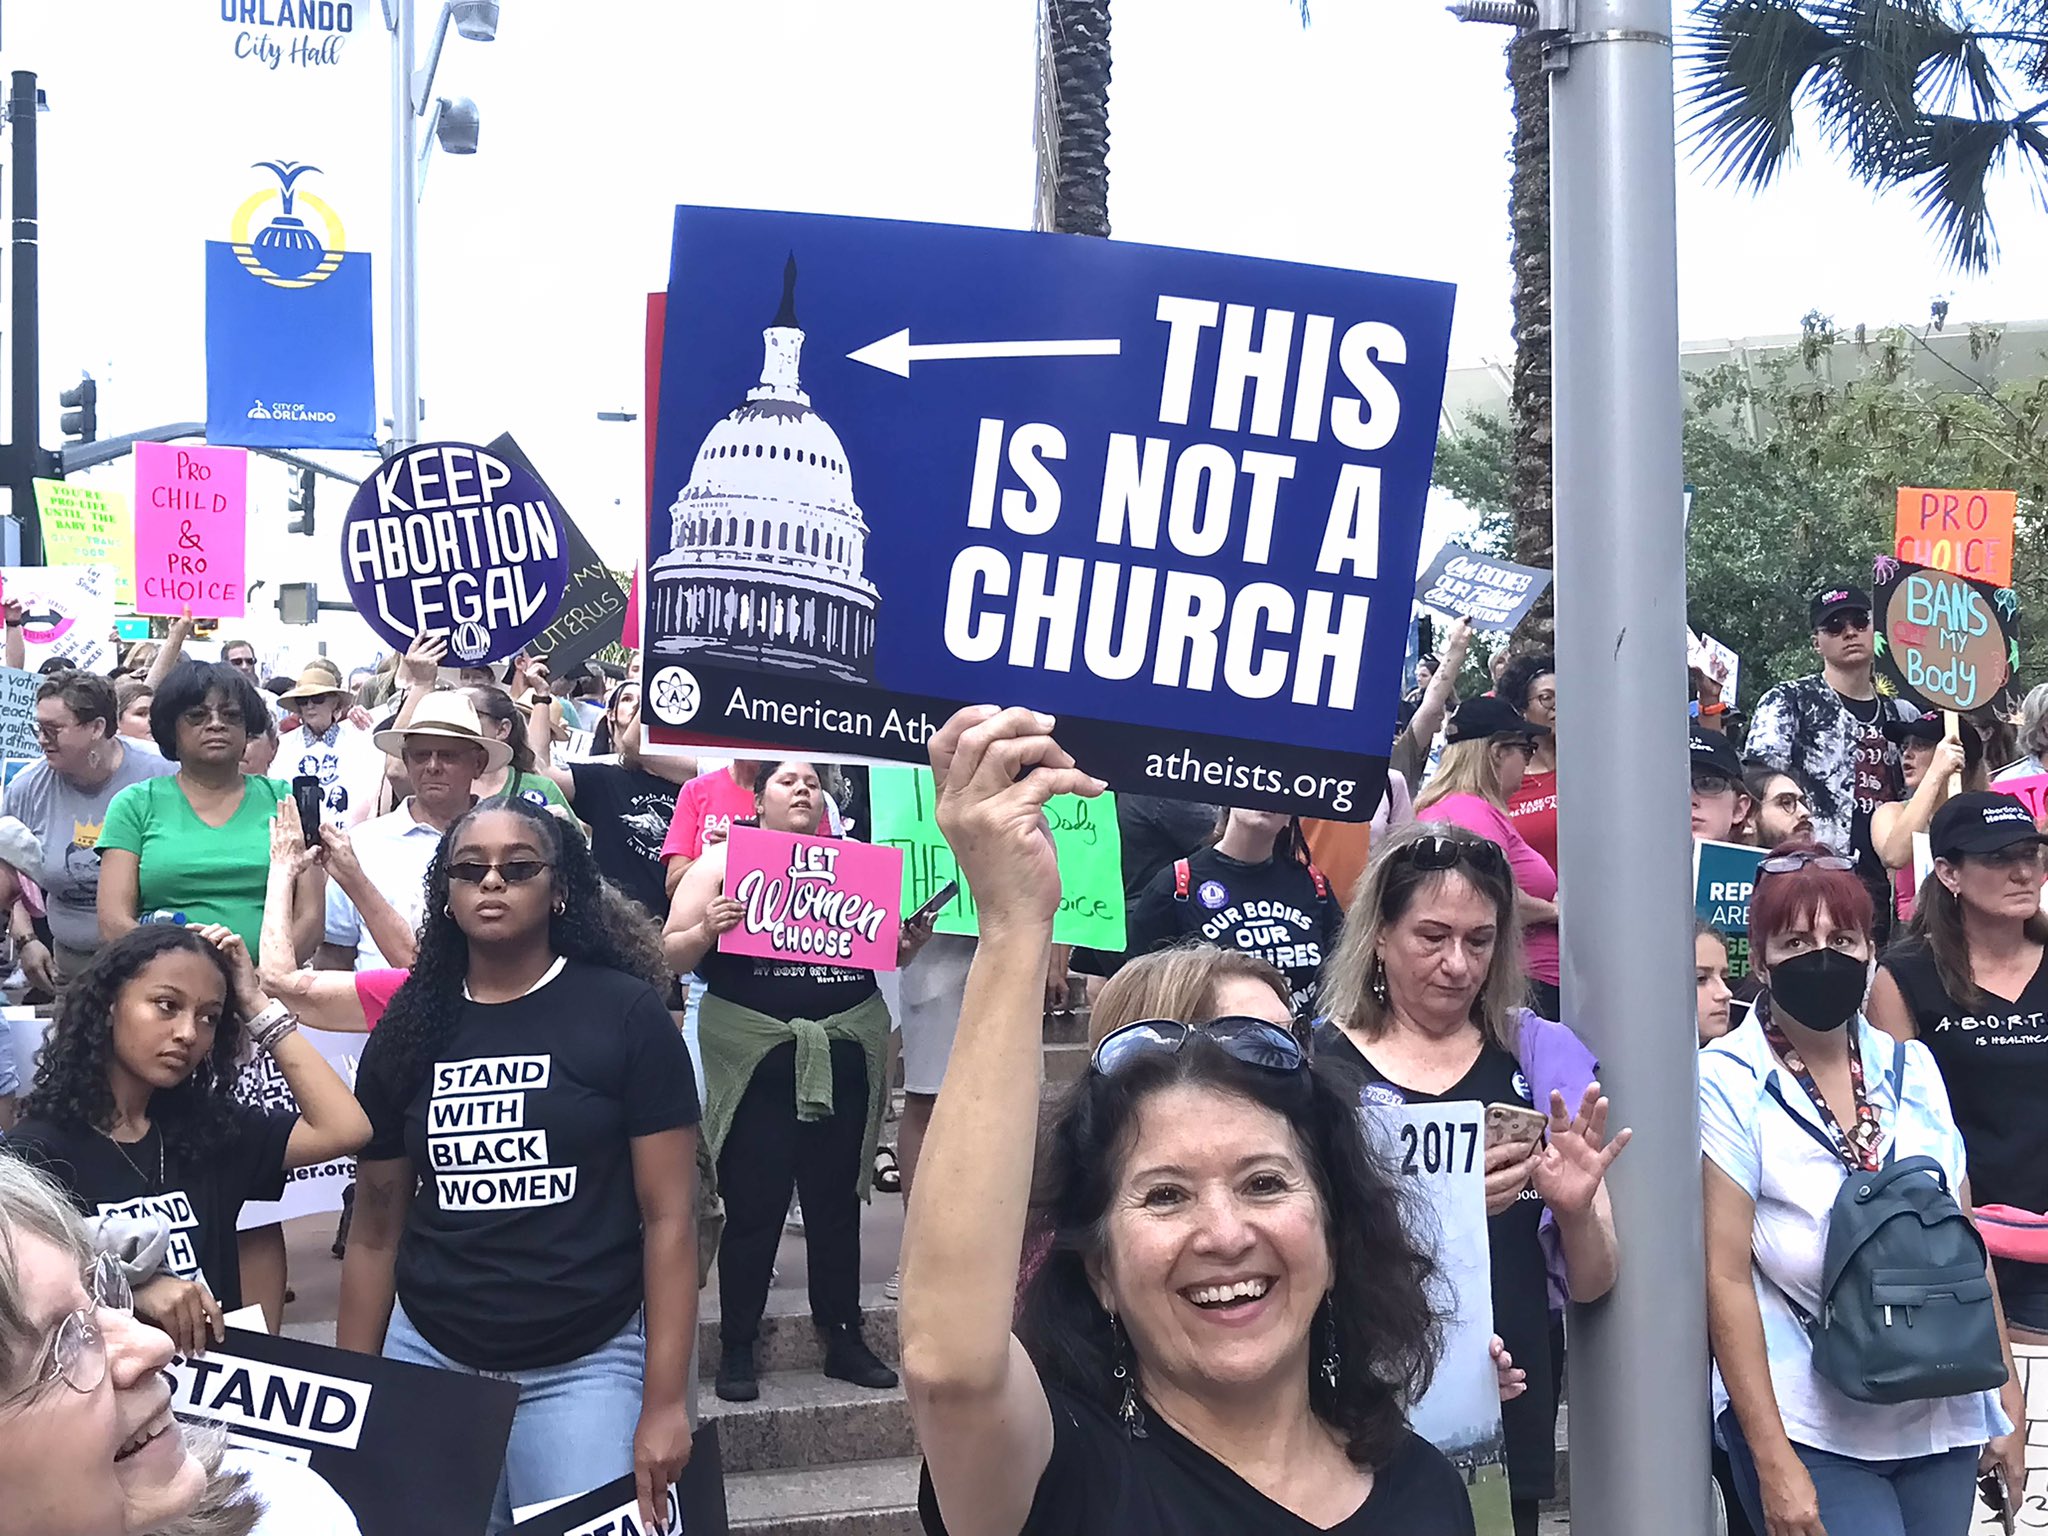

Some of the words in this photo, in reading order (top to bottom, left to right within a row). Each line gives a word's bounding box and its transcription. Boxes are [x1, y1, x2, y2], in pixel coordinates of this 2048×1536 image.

[221, 0, 353, 33] ORLANDO
[234, 31, 284, 70] City
[288, 34, 346, 68] Hall
[1155, 294, 1407, 451] THIS
[272, 402, 292, 411] CITY
[292, 403, 305, 412] OF
[272, 410, 336, 423] ORLANDO
[178, 451, 211, 481] PRO
[375, 447, 512, 514] KEEP
[152, 486, 227, 513] CHILD
[966, 417, 1068, 536] IS
[1096, 432, 1297, 565] NOT
[1315, 463, 1382, 580] A
[1920, 493, 1988, 532] PRO
[178, 520, 204, 552] &
[347, 500, 558, 583] ABORTION
[168, 553, 207, 575] PRO
[1897, 536, 2001, 574] CHOICE
[144, 577, 237, 601] CHOICE
[573, 561, 607, 588] MY
[375, 565, 548, 638] LEGAL
[1906, 575, 1989, 637] BANS
[533, 592, 619, 653] UTERUS
[943, 545, 1370, 711] CHURCH
[1940, 627, 1969, 654] MY
[1907, 648, 1975, 708] Body
[9, 687, 36, 708] hist
[724, 686, 872, 737] American
[880, 708, 938, 745] Ath
[1145, 748, 1357, 812] atheists.org
[1520, 795, 1557, 809] VASECT
[704, 813, 757, 830] BA
[793, 842, 840, 873] LET
[737, 866, 887, 942] Women
[1058, 891, 1114, 920] oice
[1709, 881, 1754, 902] REP
[1201, 906, 1243, 940] OUR
[1243, 900, 1313, 931] BODIES
[772, 921, 853, 957] CHOOSE
[1235, 926, 1291, 949] OUR
[1975, 1036, 1988, 1046] IS
[1991, 1034, 2048, 1045] HEALTHCA
[438, 1061, 544, 1091] STAND
[433, 1099, 518, 1128] WITH
[432, 1136, 542, 1166] BLACK
[1400, 1121, 1478, 1176] 2017
[440, 1172, 572, 1206] WOMEN
